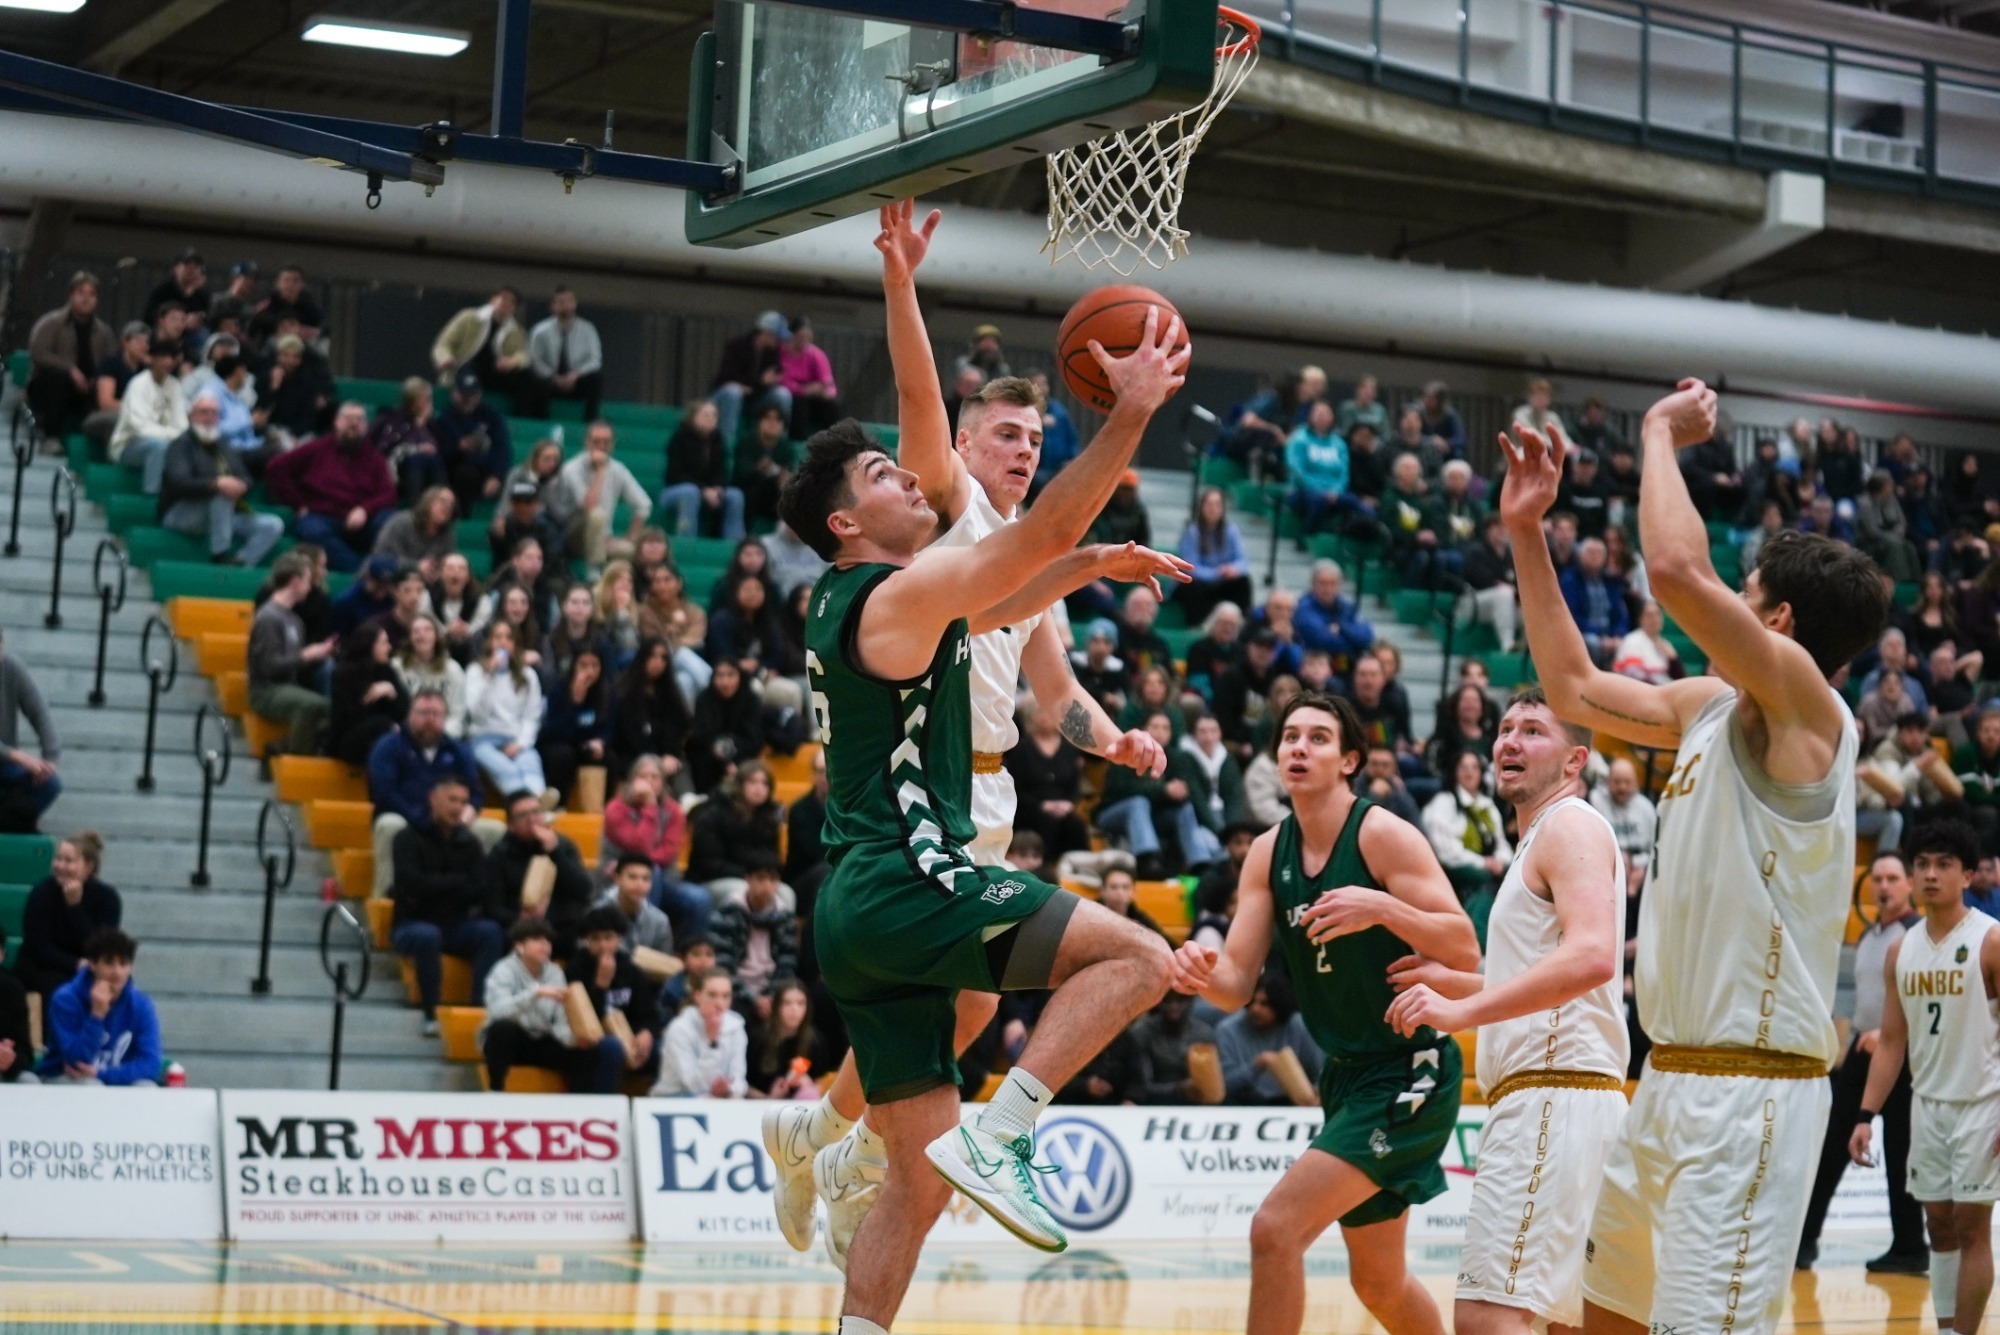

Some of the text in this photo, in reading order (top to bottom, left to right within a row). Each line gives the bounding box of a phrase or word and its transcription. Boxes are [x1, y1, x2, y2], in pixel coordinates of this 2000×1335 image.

[1904, 969, 1964, 997] UNBC
[1928, 1001, 1942, 1035] 2
[236, 1116, 621, 1161] MR MIKES
[1257, 1116, 1322, 1142] CIT
[8, 1140, 211, 1162] PROUD SUPPORTER
[650, 1112, 774, 1193] Ea
[1180, 1148, 1297, 1171] Volkswa
[9, 1160, 214, 1182] OF UNBC ATHLETICS
[1225, 1193, 1257, 1214] Fam
[241, 1210, 626, 1223] PROUD SUPPORTER OF UNBC ATHLETICS PLAYER OF THE GAME
[698, 1216, 774, 1232] KITCHE
